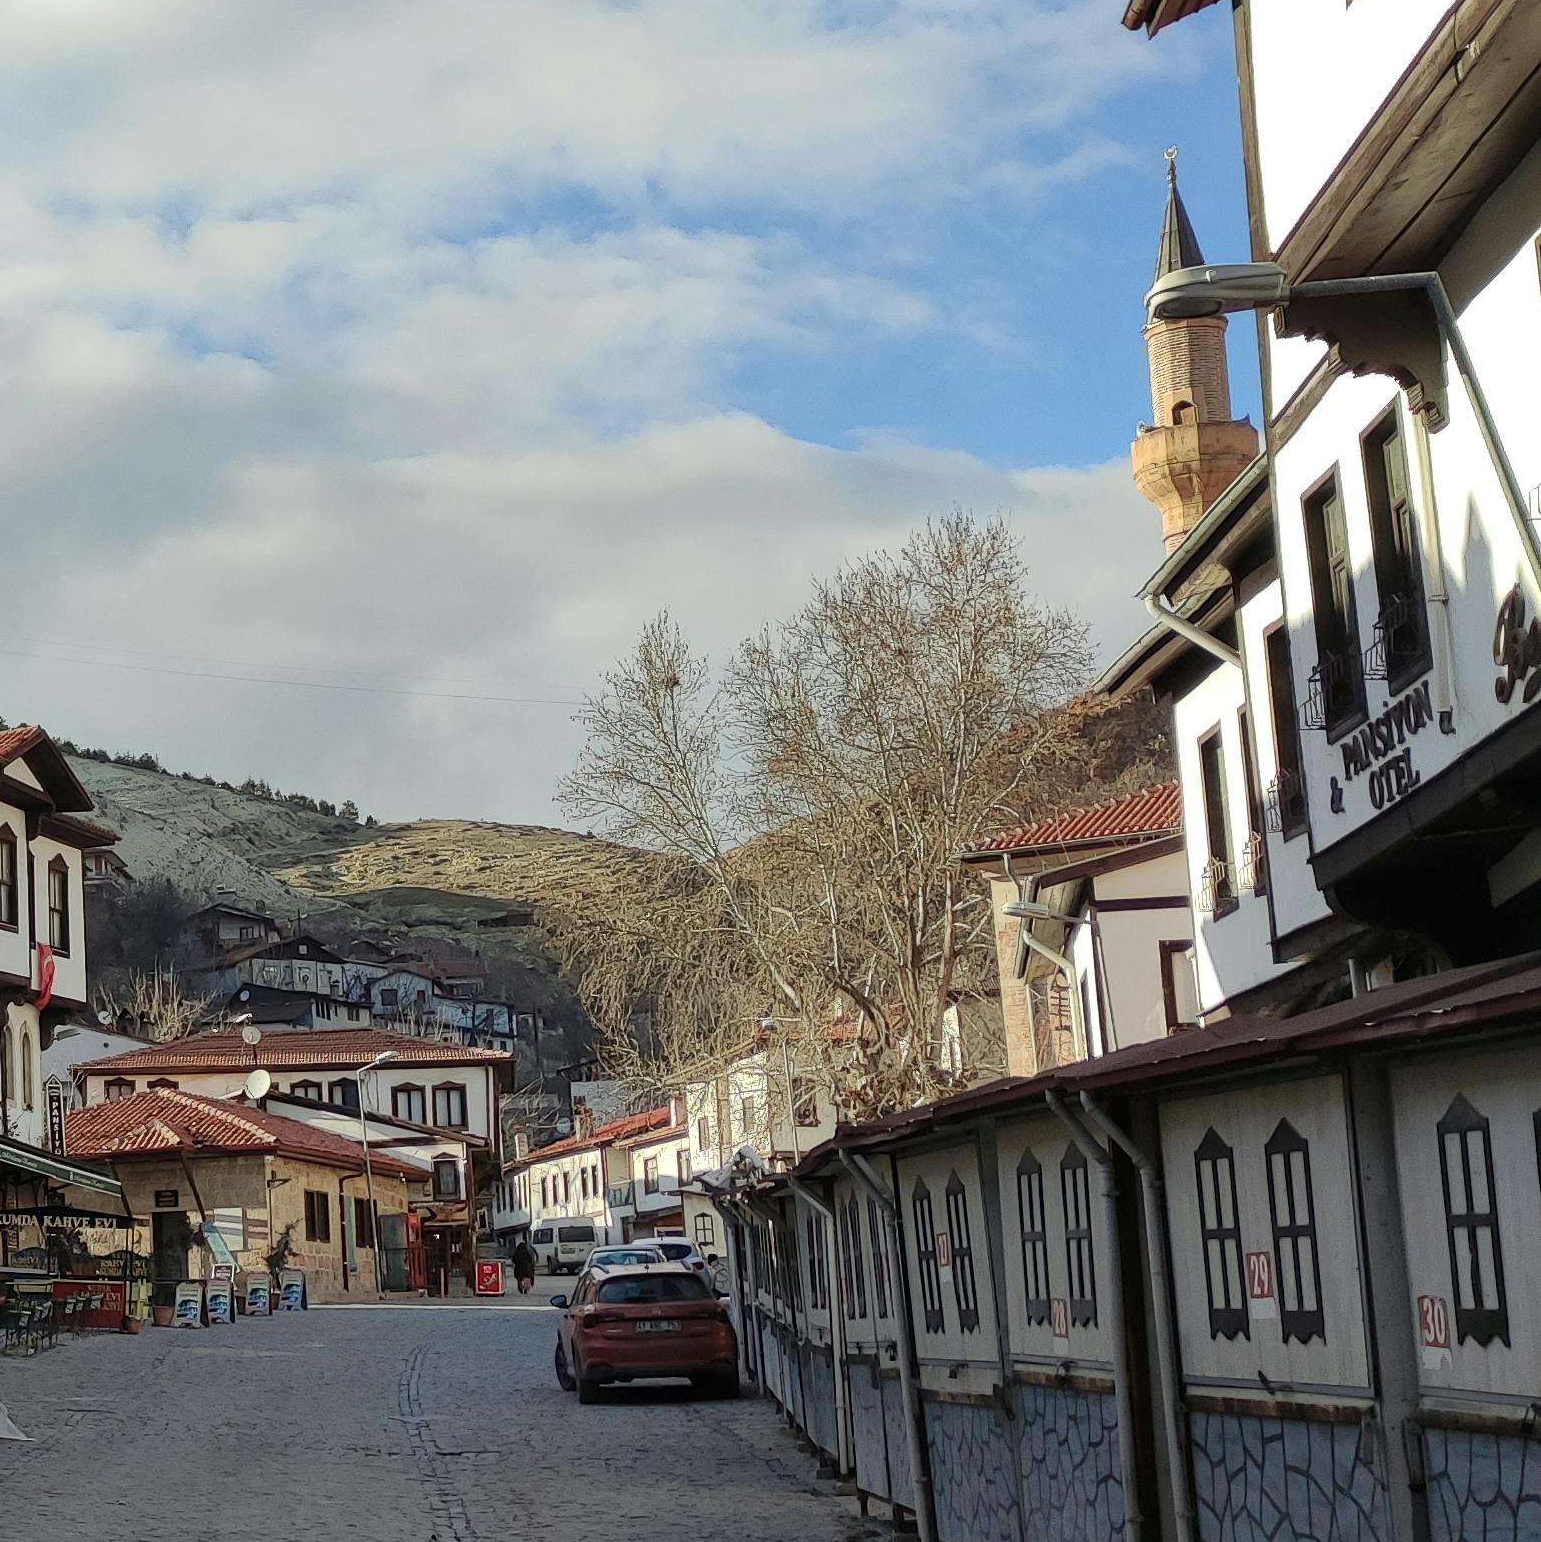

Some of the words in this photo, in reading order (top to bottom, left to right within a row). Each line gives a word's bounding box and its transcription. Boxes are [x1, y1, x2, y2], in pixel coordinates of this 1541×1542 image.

[1340, 679, 1434, 781] PANSİYON
[1369, 747, 1420, 810] OTEL
[43, 1215, 90, 1229] KAHVE
[1250, 1254, 1269, 1295] 29
[1423, 1297, 1446, 1343] 30
